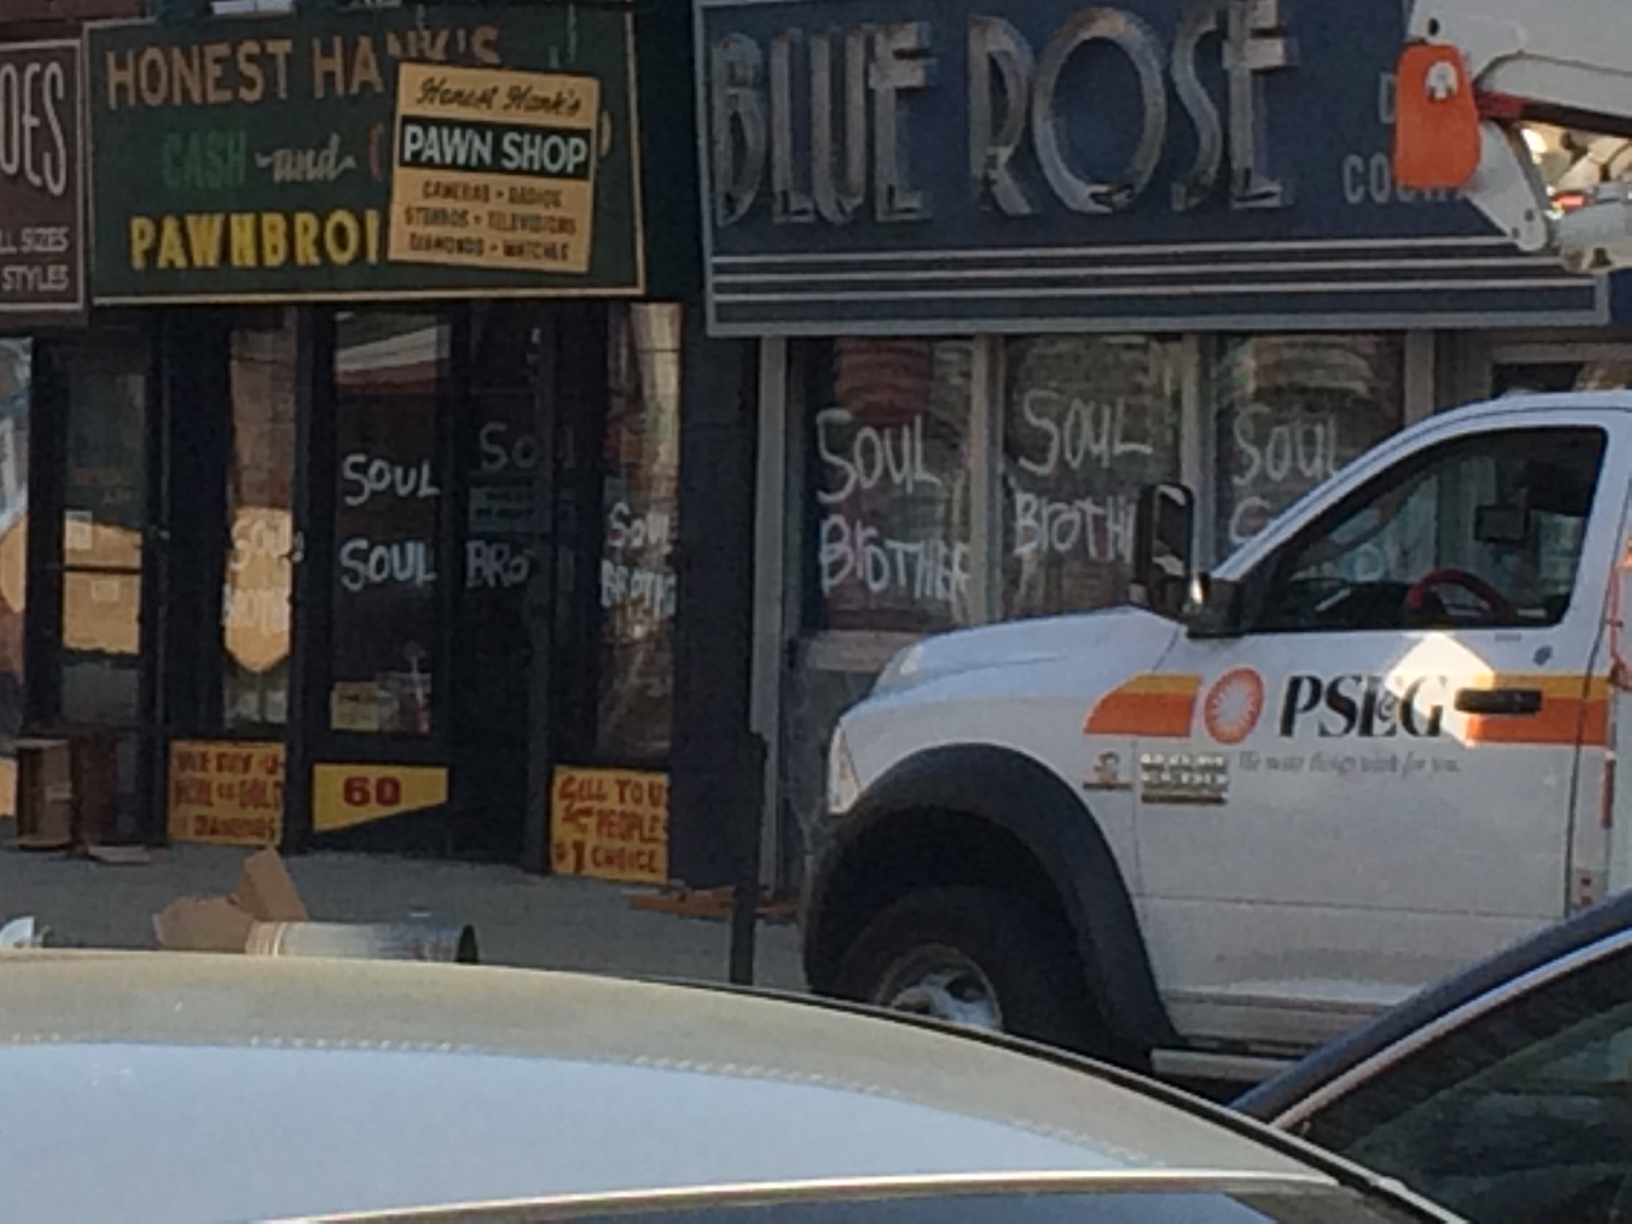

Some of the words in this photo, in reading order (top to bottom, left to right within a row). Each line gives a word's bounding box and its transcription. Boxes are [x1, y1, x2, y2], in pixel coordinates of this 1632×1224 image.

[105, 38, 294, 110] HONEST
[403, 123, 494, 165] PAWN
[500, 130, 589, 174] SHOP
[713, 20, 934, 228] BLUE
[162, 130, 247, 188] CASH
[2, 264, 70, 292] STYLES
[817, 408, 942, 504] SOUL
[1019, 389, 1154, 476] SOUL
[342, 452, 441, 506] SOUL
[340, 537, 438, 592] SOUL
[342, 776, 402, 807] 60
